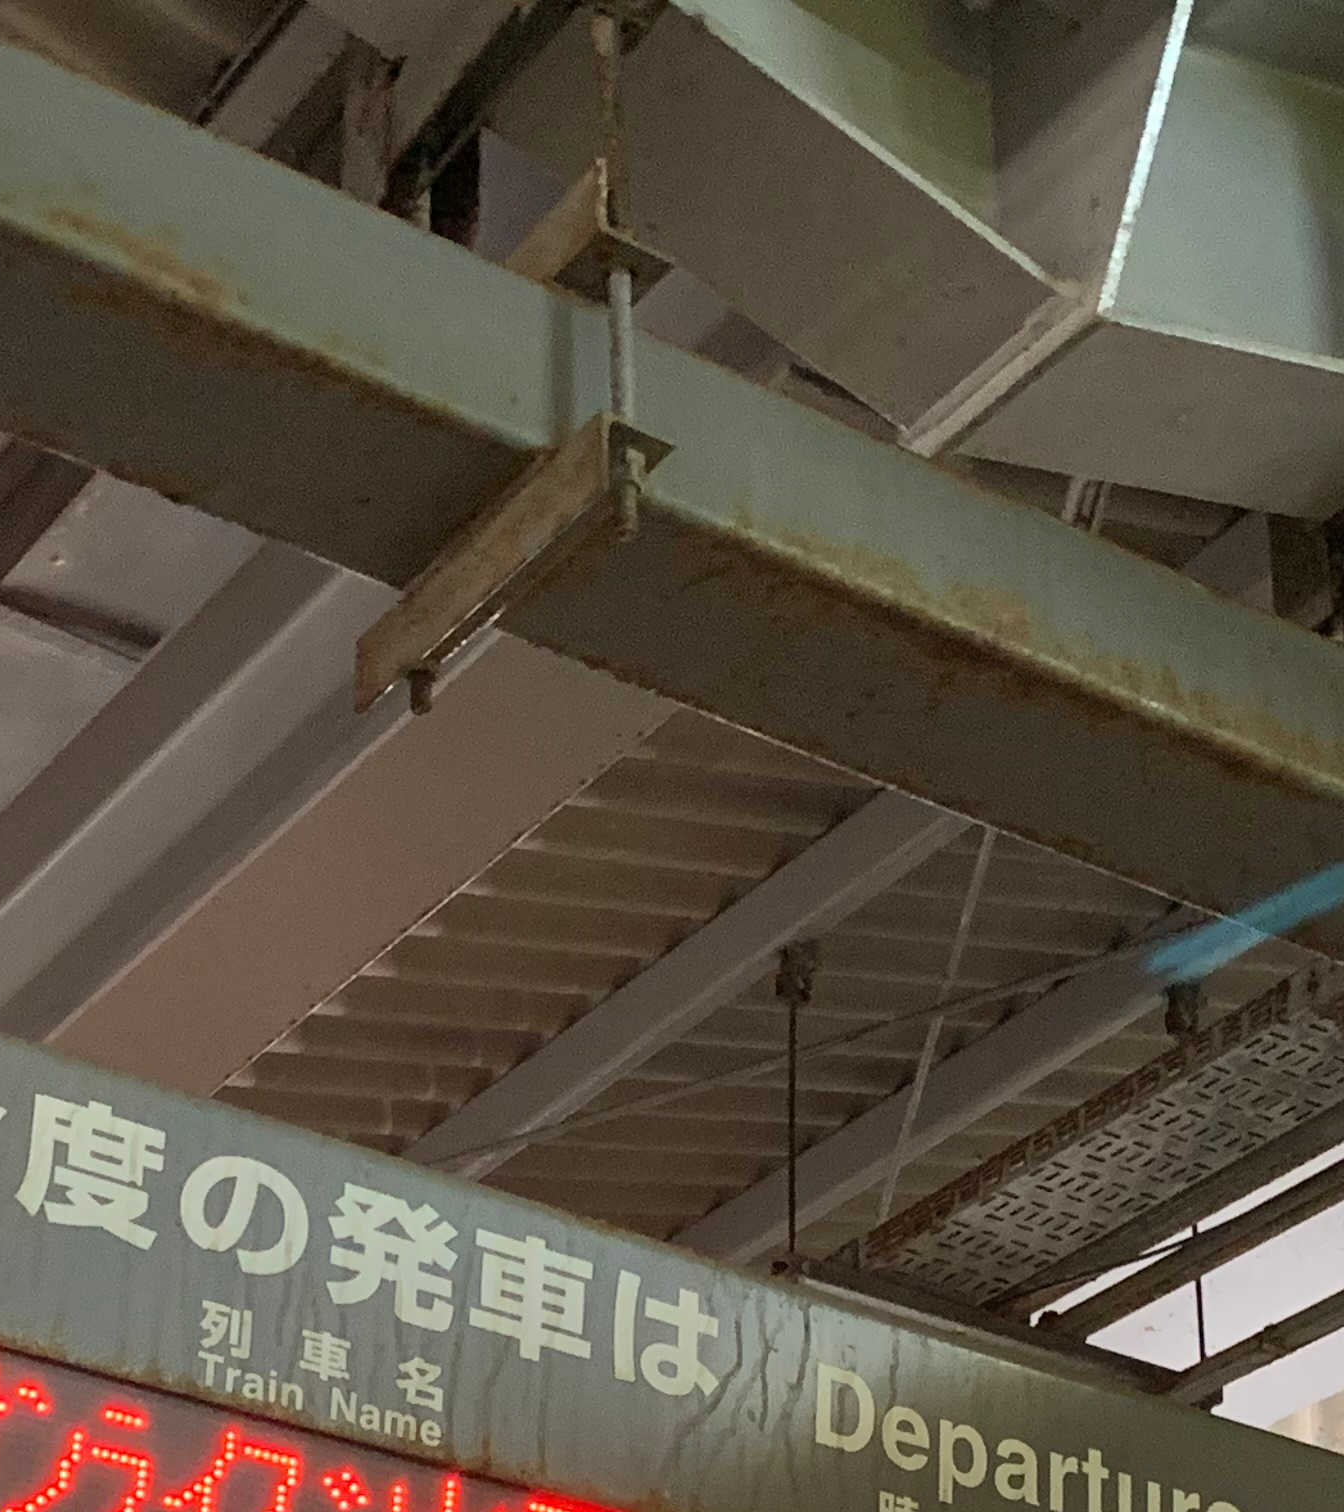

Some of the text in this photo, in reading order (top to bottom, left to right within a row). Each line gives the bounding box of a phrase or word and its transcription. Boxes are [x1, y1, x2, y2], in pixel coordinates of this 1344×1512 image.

[198, 1350, 442, 1447] Train Name
[200, 1300, 444, 1412] 列車名
